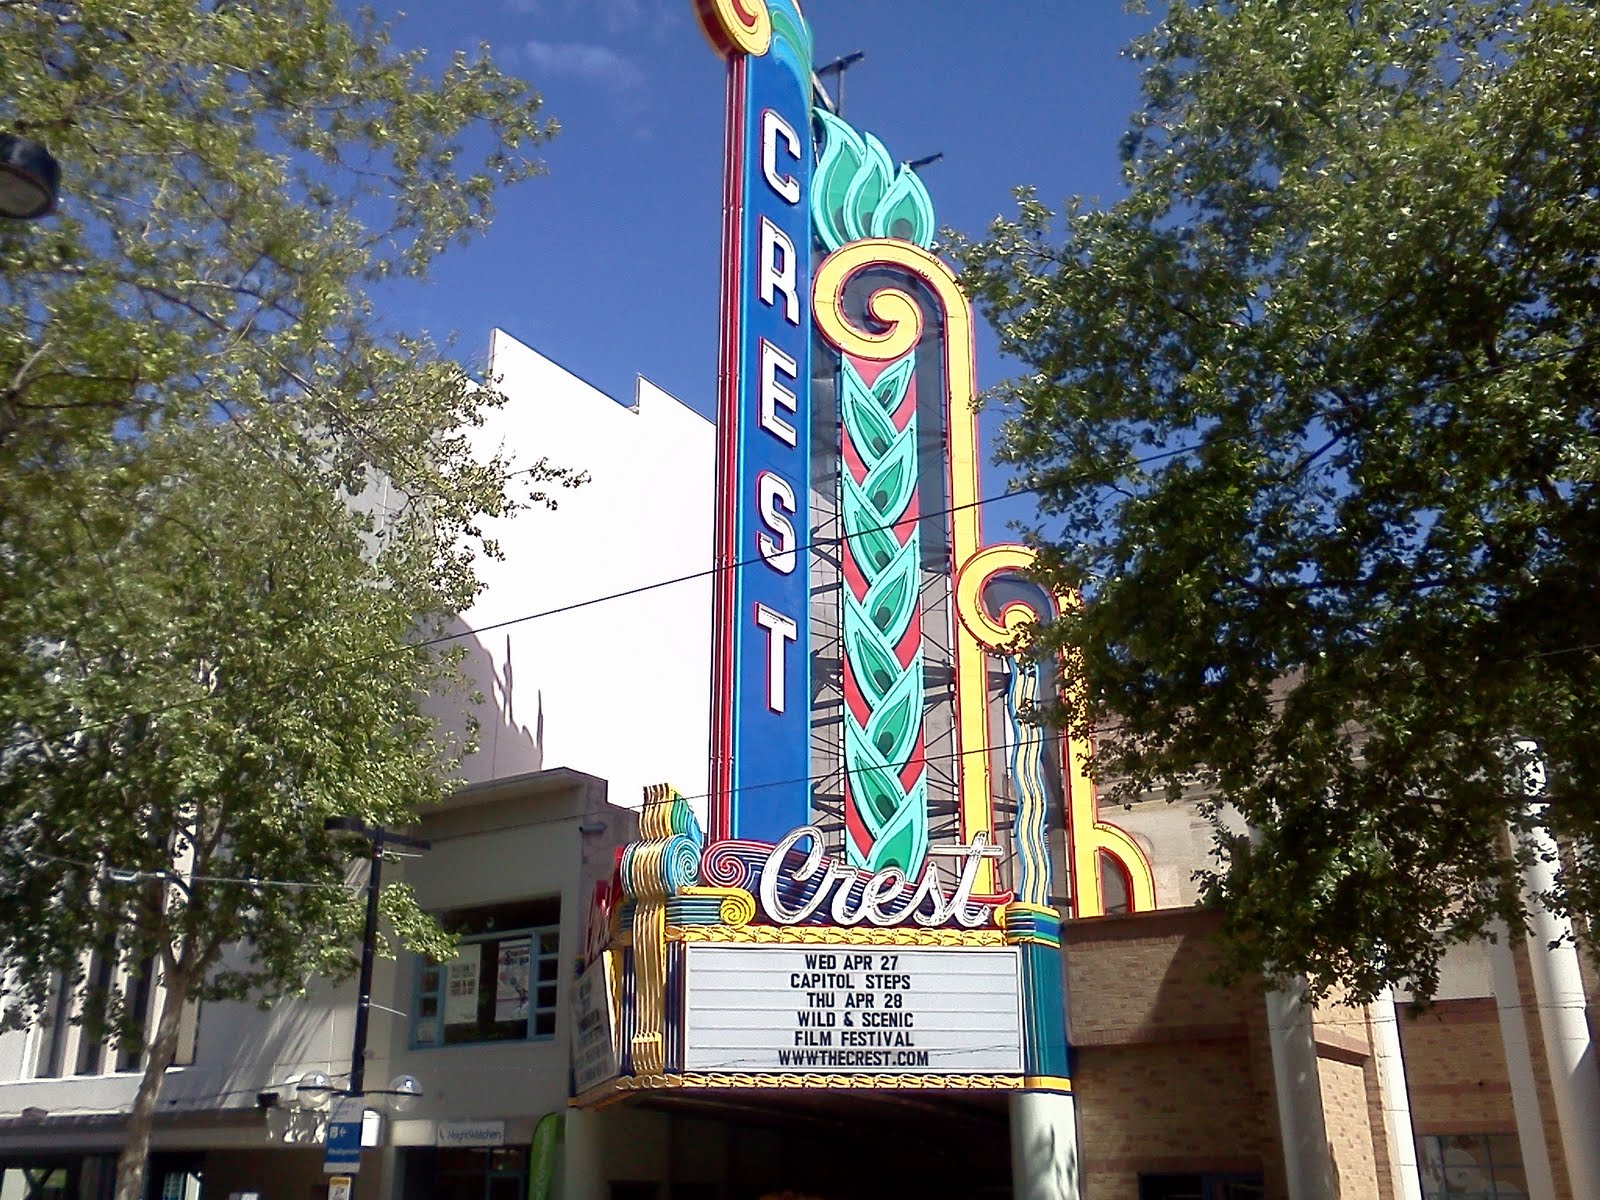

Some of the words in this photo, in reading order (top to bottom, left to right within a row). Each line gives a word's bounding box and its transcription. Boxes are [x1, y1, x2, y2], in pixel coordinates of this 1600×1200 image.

[757, 107, 800, 714] CREST
[760, 825, 1003, 928] Crest
[804, 954, 836, 971] WED
[843, 954, 873, 971] APR
[880, 955, 899, 971] 27
[790, 973, 855, 989] CAPITOL
[865, 974, 911, 990] STEPS
[806, 992, 835, 1008] THU
[844, 993, 875, 1009] APR
[884, 994, 903, 1009] 28
[797, 1011, 836, 1027] WILD
[843, 1012, 854, 1027] &
[861, 1012, 914, 1028] SCENIC
[794, 1031, 832, 1047] FILM
[841, 1031, 915, 1047] FESTIVAL
